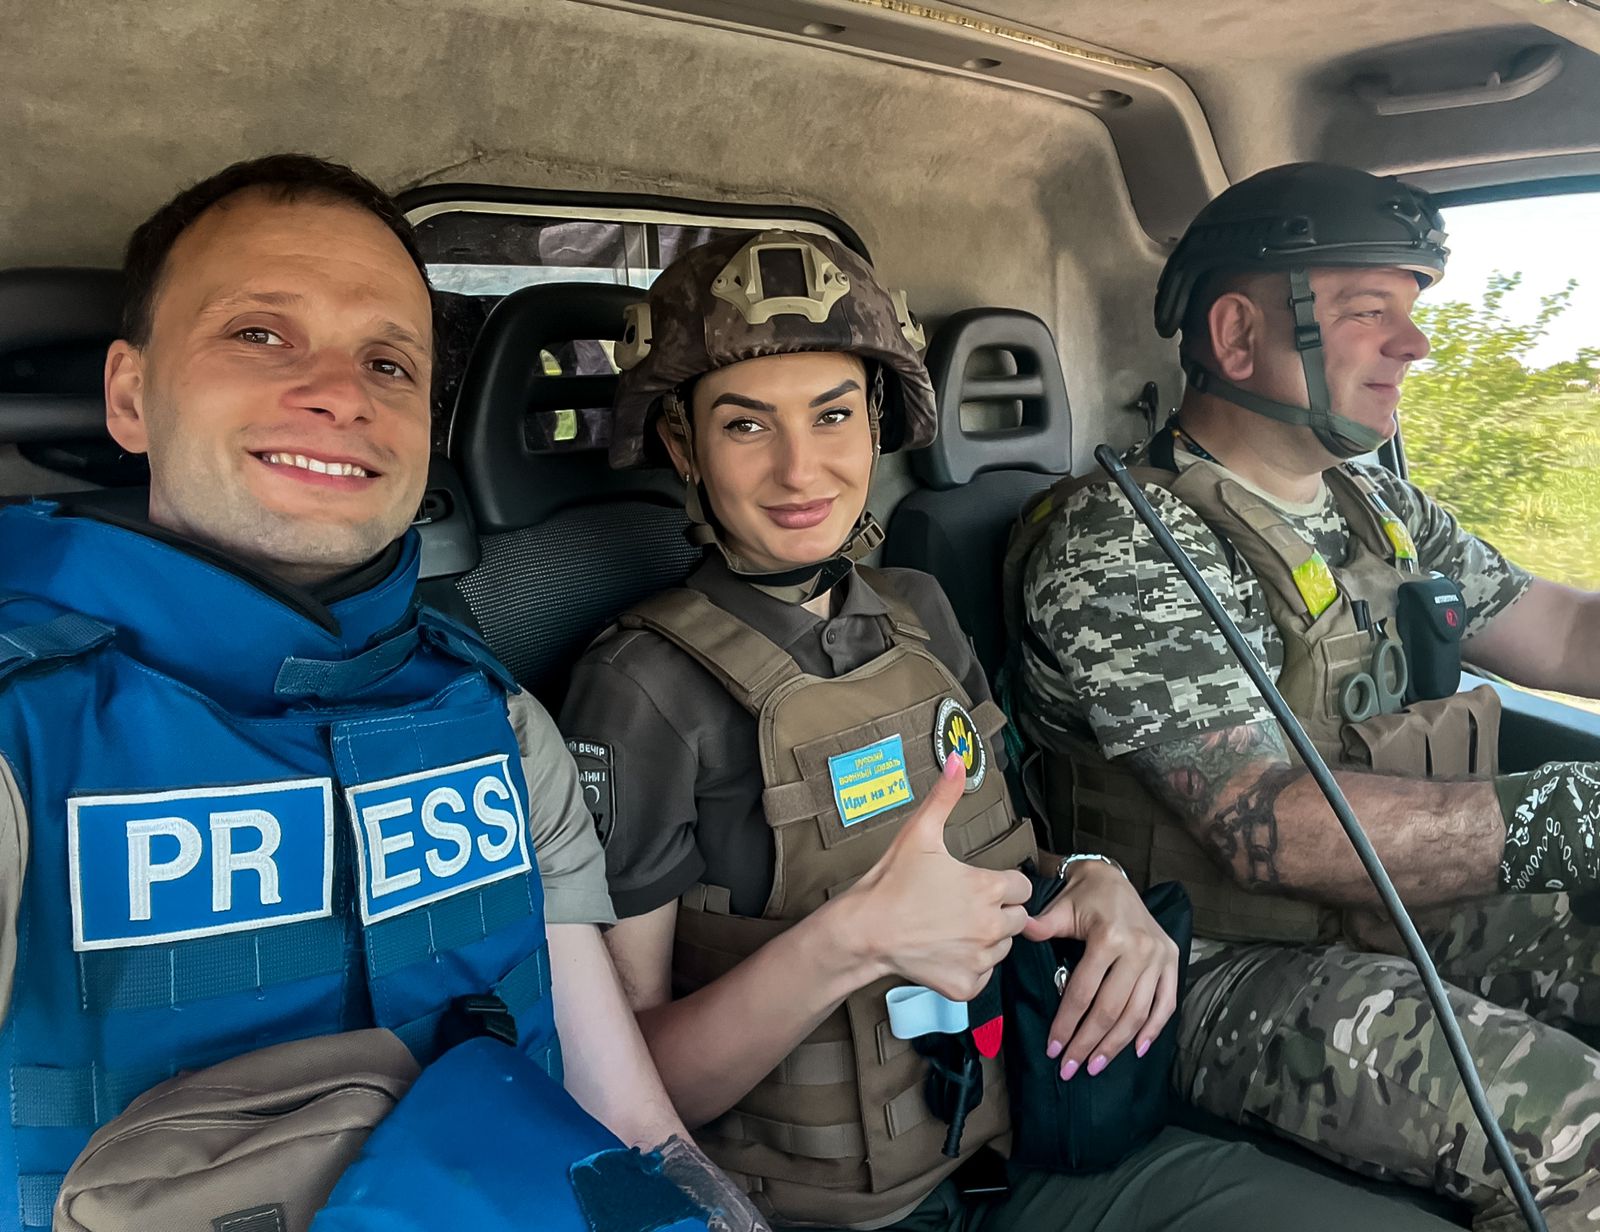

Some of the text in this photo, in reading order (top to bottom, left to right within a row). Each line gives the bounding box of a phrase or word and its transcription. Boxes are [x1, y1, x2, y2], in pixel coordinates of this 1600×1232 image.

[579, 743, 604, 756] ВЕЧІР
[843, 795, 868, 810] Иди
[870, 788, 885, 801] на
